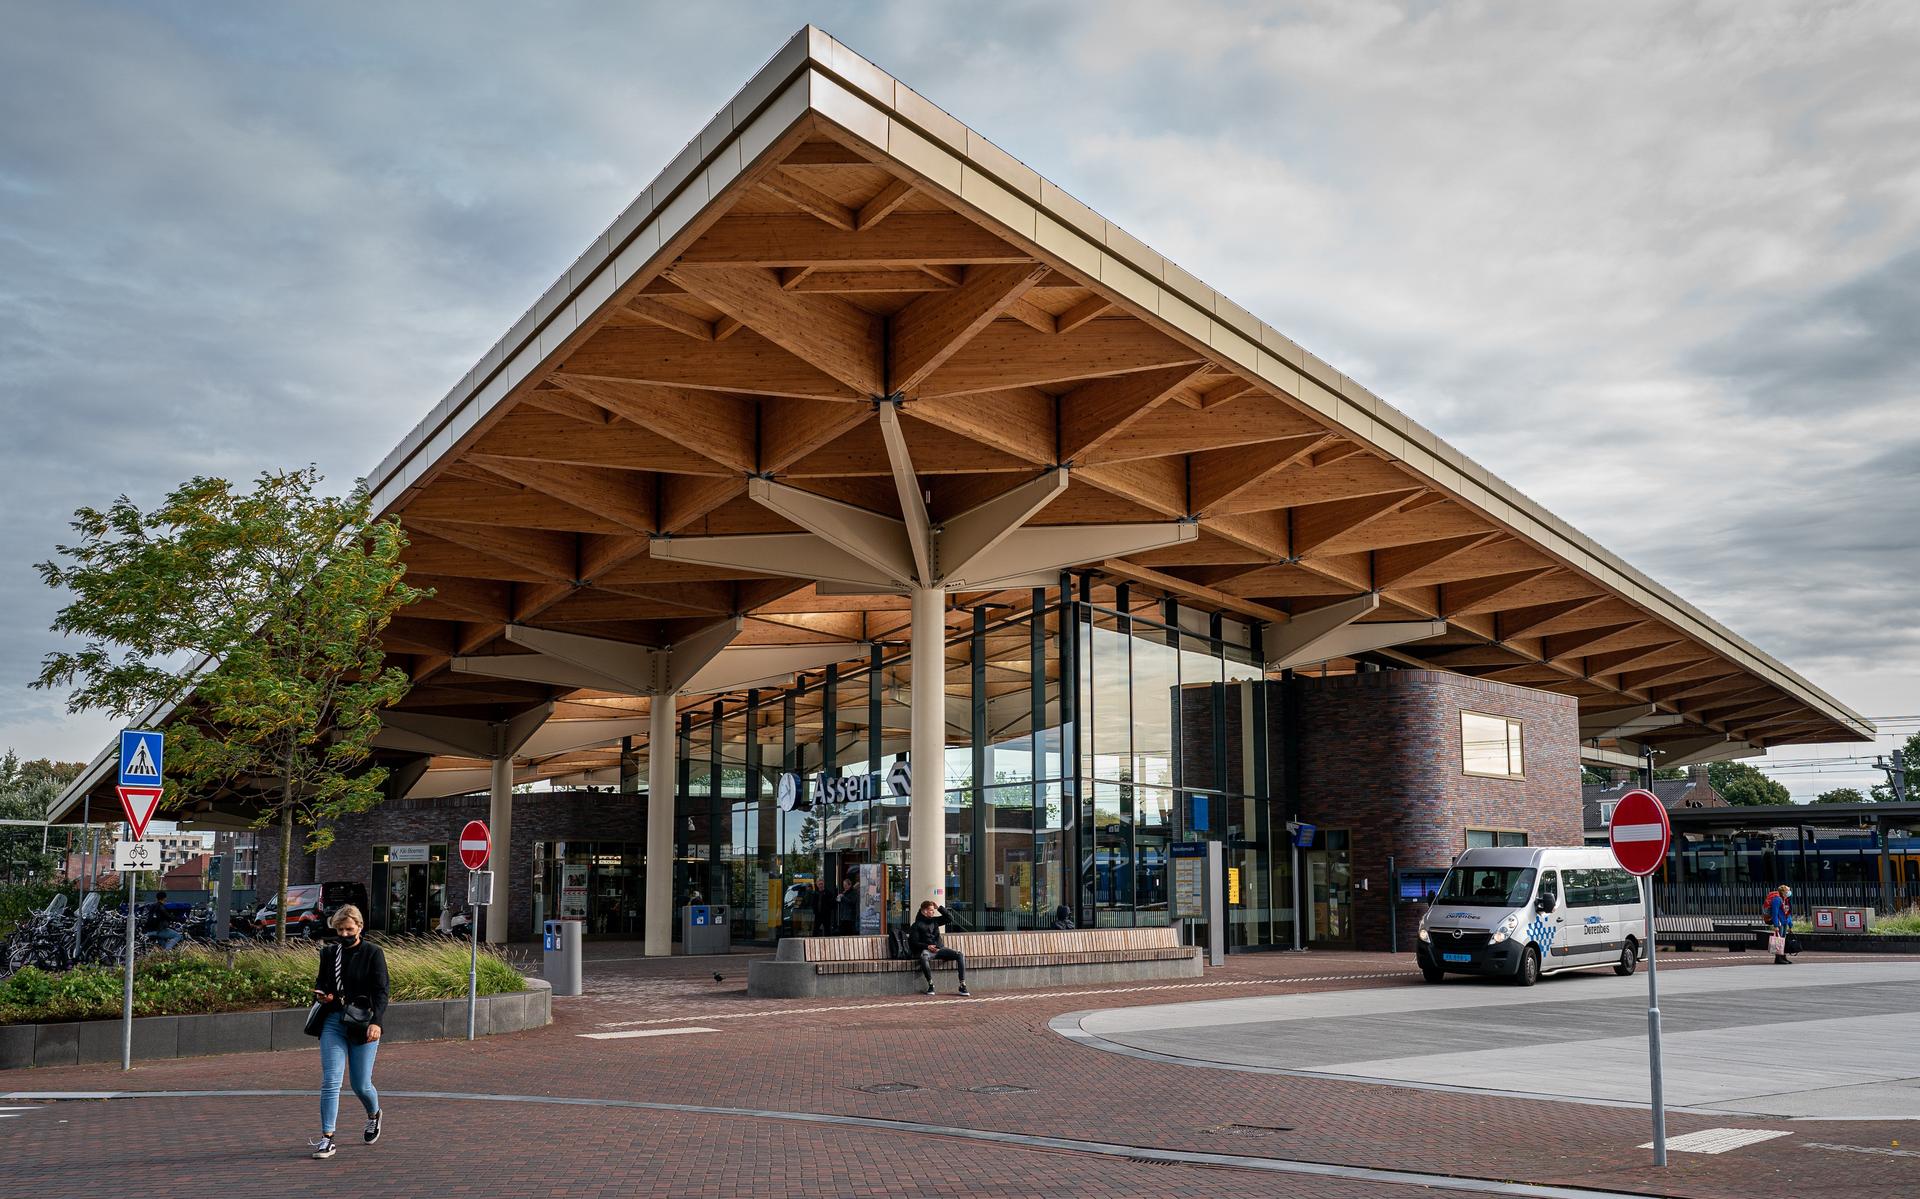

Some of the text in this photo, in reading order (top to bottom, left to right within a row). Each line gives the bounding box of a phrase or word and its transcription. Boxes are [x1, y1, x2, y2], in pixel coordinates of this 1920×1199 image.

[812, 773, 871, 805] Assen
[1709, 861, 1716, 870] 2
[1823, 860, 1831, 870] 2
